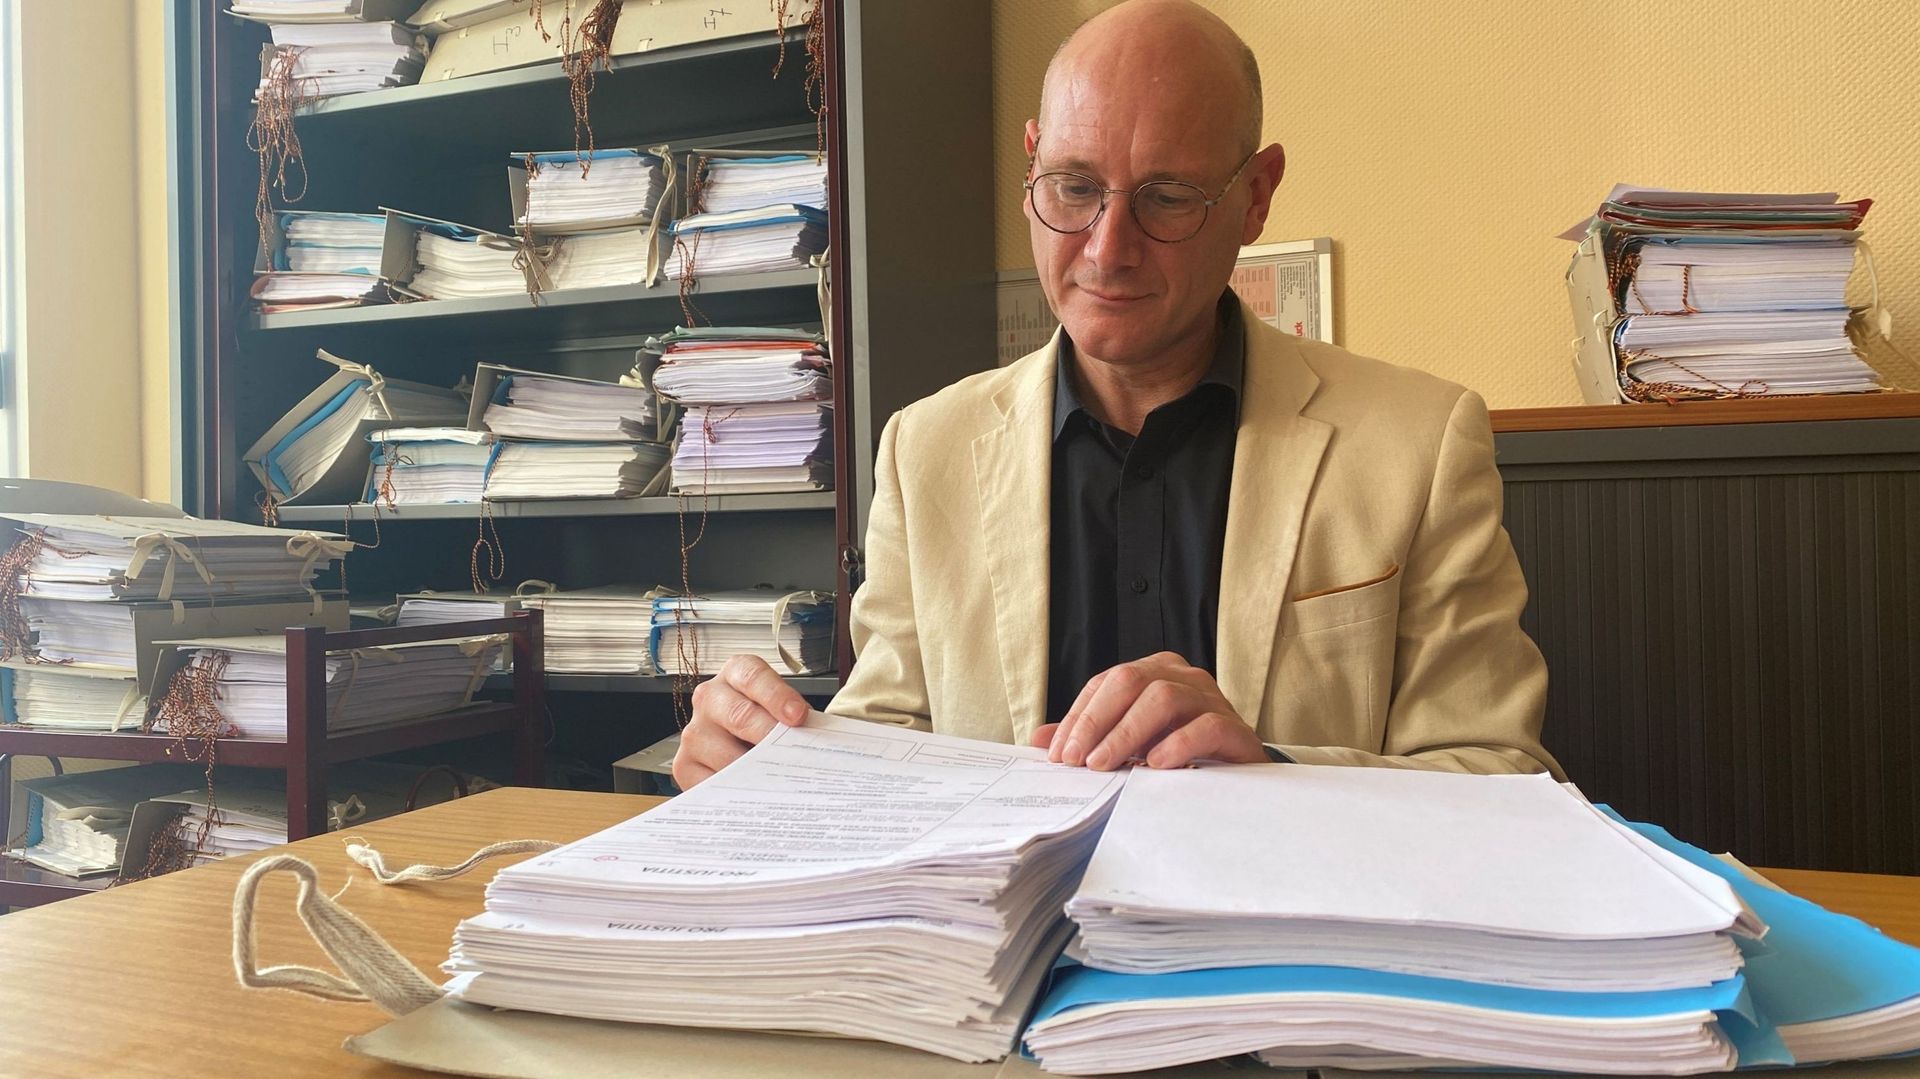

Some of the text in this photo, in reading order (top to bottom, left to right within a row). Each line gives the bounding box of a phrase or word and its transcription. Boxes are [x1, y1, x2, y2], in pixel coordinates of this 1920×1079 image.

[642, 866, 758, 877] PRO JUSTITIA
[607, 922, 728, 934] PRO JUSTITIA
